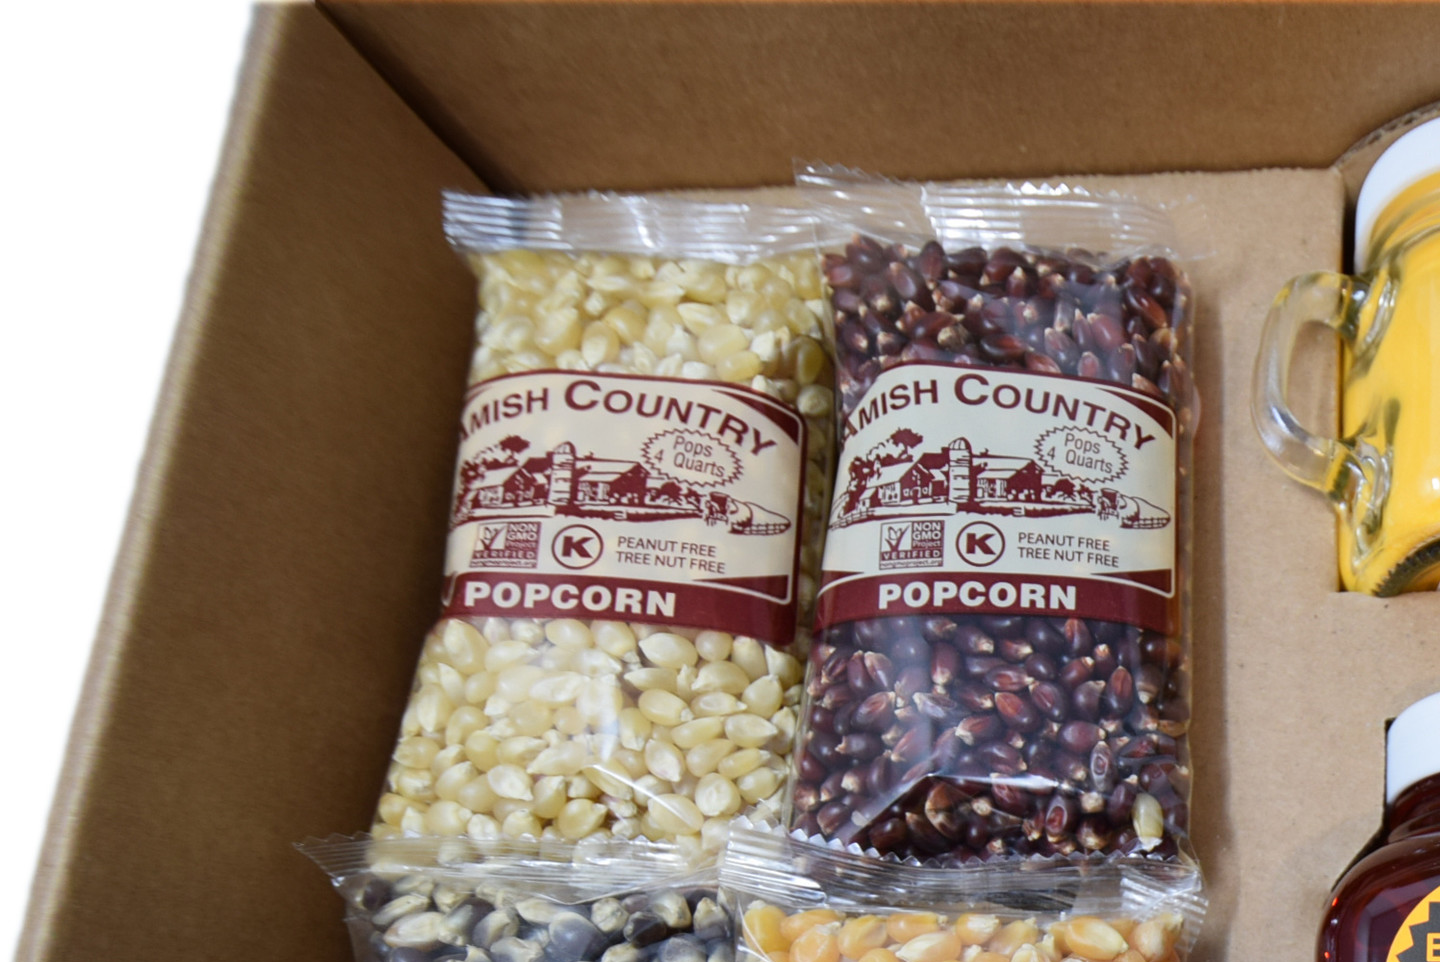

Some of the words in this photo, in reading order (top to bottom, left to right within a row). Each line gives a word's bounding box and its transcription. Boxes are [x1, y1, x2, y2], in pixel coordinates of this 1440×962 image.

[564, 380, 777, 457] COUNTRY
[954, 374, 1156, 449] COUNTRY
[673, 436, 712, 458] Pops
[1064, 433, 1100, 454] Pops
[654, 449, 664, 463] 4
[673, 454, 725, 477] Quarts
[1047, 446, 1056, 461] 4
[1066, 451, 1113, 474] Quarts
[914, 522, 941, 531] NON
[914, 531, 941, 540] GMO
[562, 536, 594, 558] K
[617, 536, 678, 552] PEANUT
[681, 542, 716, 557] FREE
[966, 533, 996, 555] K
[1018, 532, 1075, 547] PEANUT
[1077, 536, 1110, 551] FREE
[617, 551, 650, 564] TREE
[655, 552, 686, 569] NUT
[691, 559, 725, 574] FREE
[884, 551, 941, 559] VERIFIED
[1018, 547, 1050, 559] TREE
[1054, 549, 1086, 563] NUT
[1089, 553, 1119, 567] FREE
[464, 581, 676, 617] POPCORN
[878, 581, 1076, 610] POPCORN
